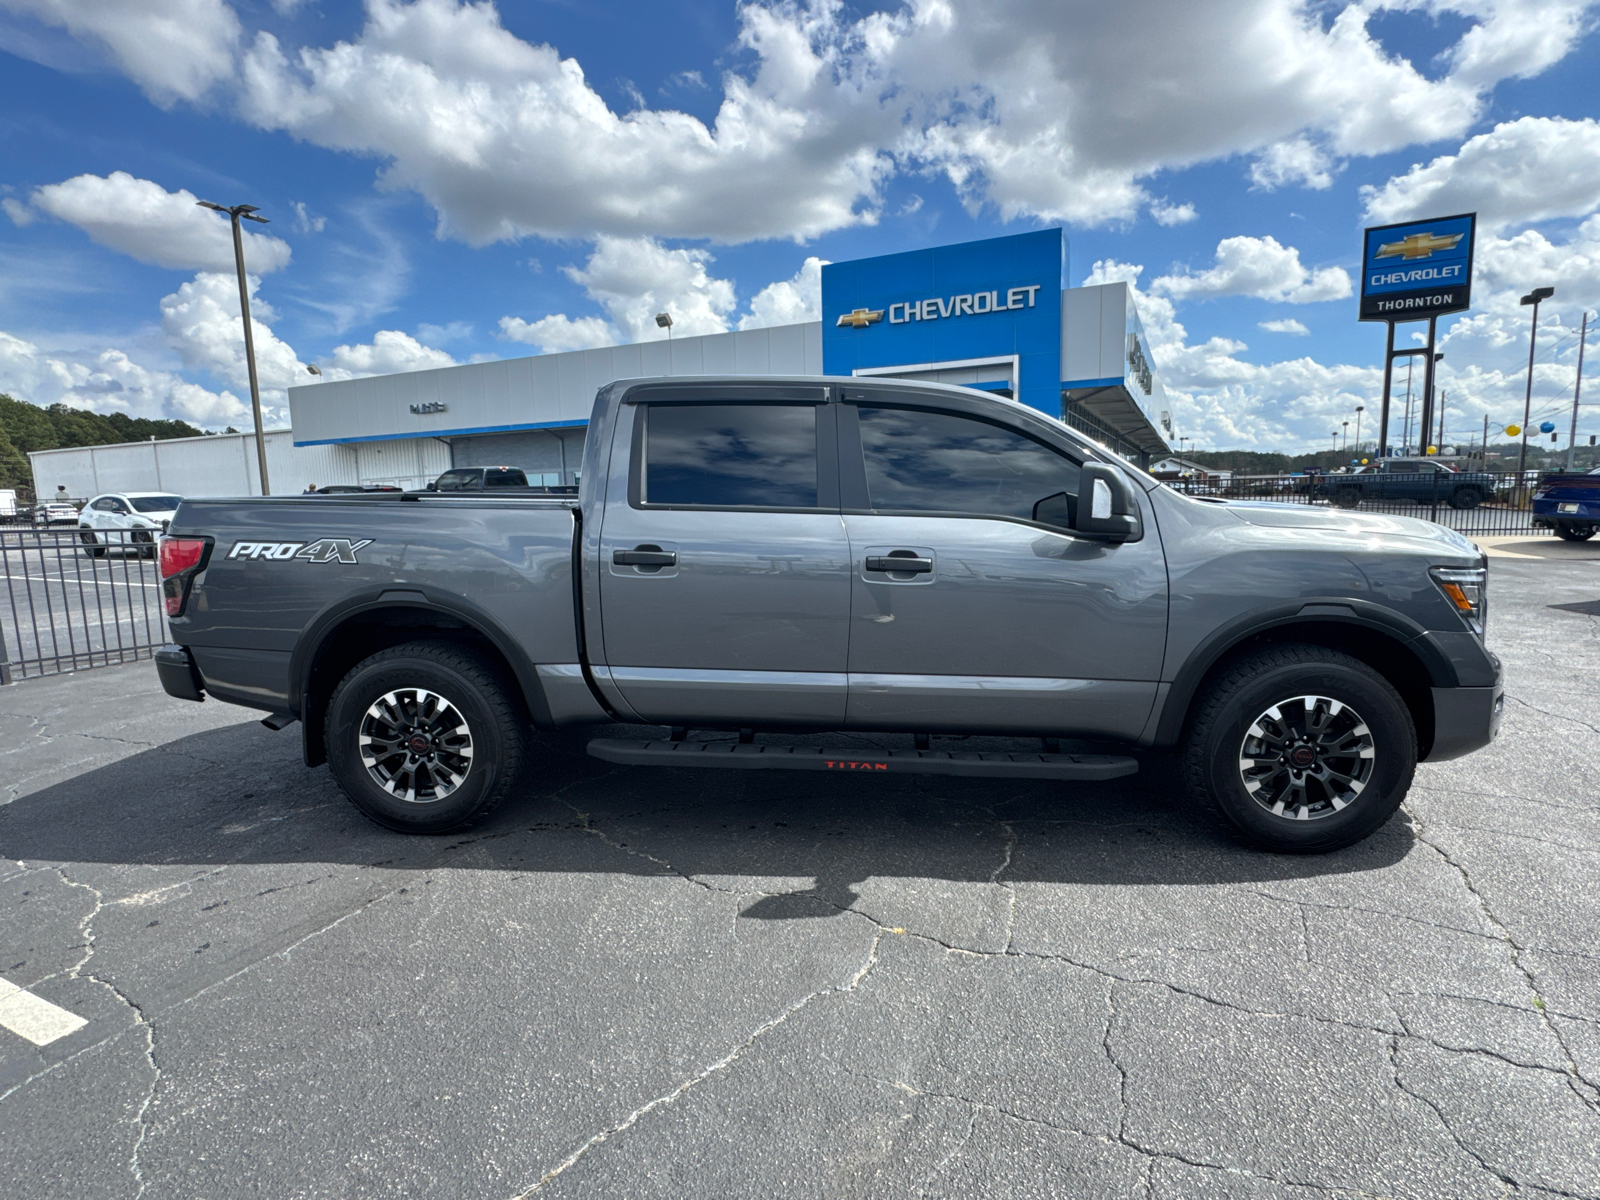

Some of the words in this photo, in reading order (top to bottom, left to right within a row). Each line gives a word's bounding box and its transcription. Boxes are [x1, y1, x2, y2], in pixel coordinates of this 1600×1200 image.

[1371, 265, 1462, 286] CHEVROLET
[889, 285, 1041, 324] CHEVROLET
[1377, 294, 1453, 311] THORNTON
[824, 761, 888, 770] TITAN
